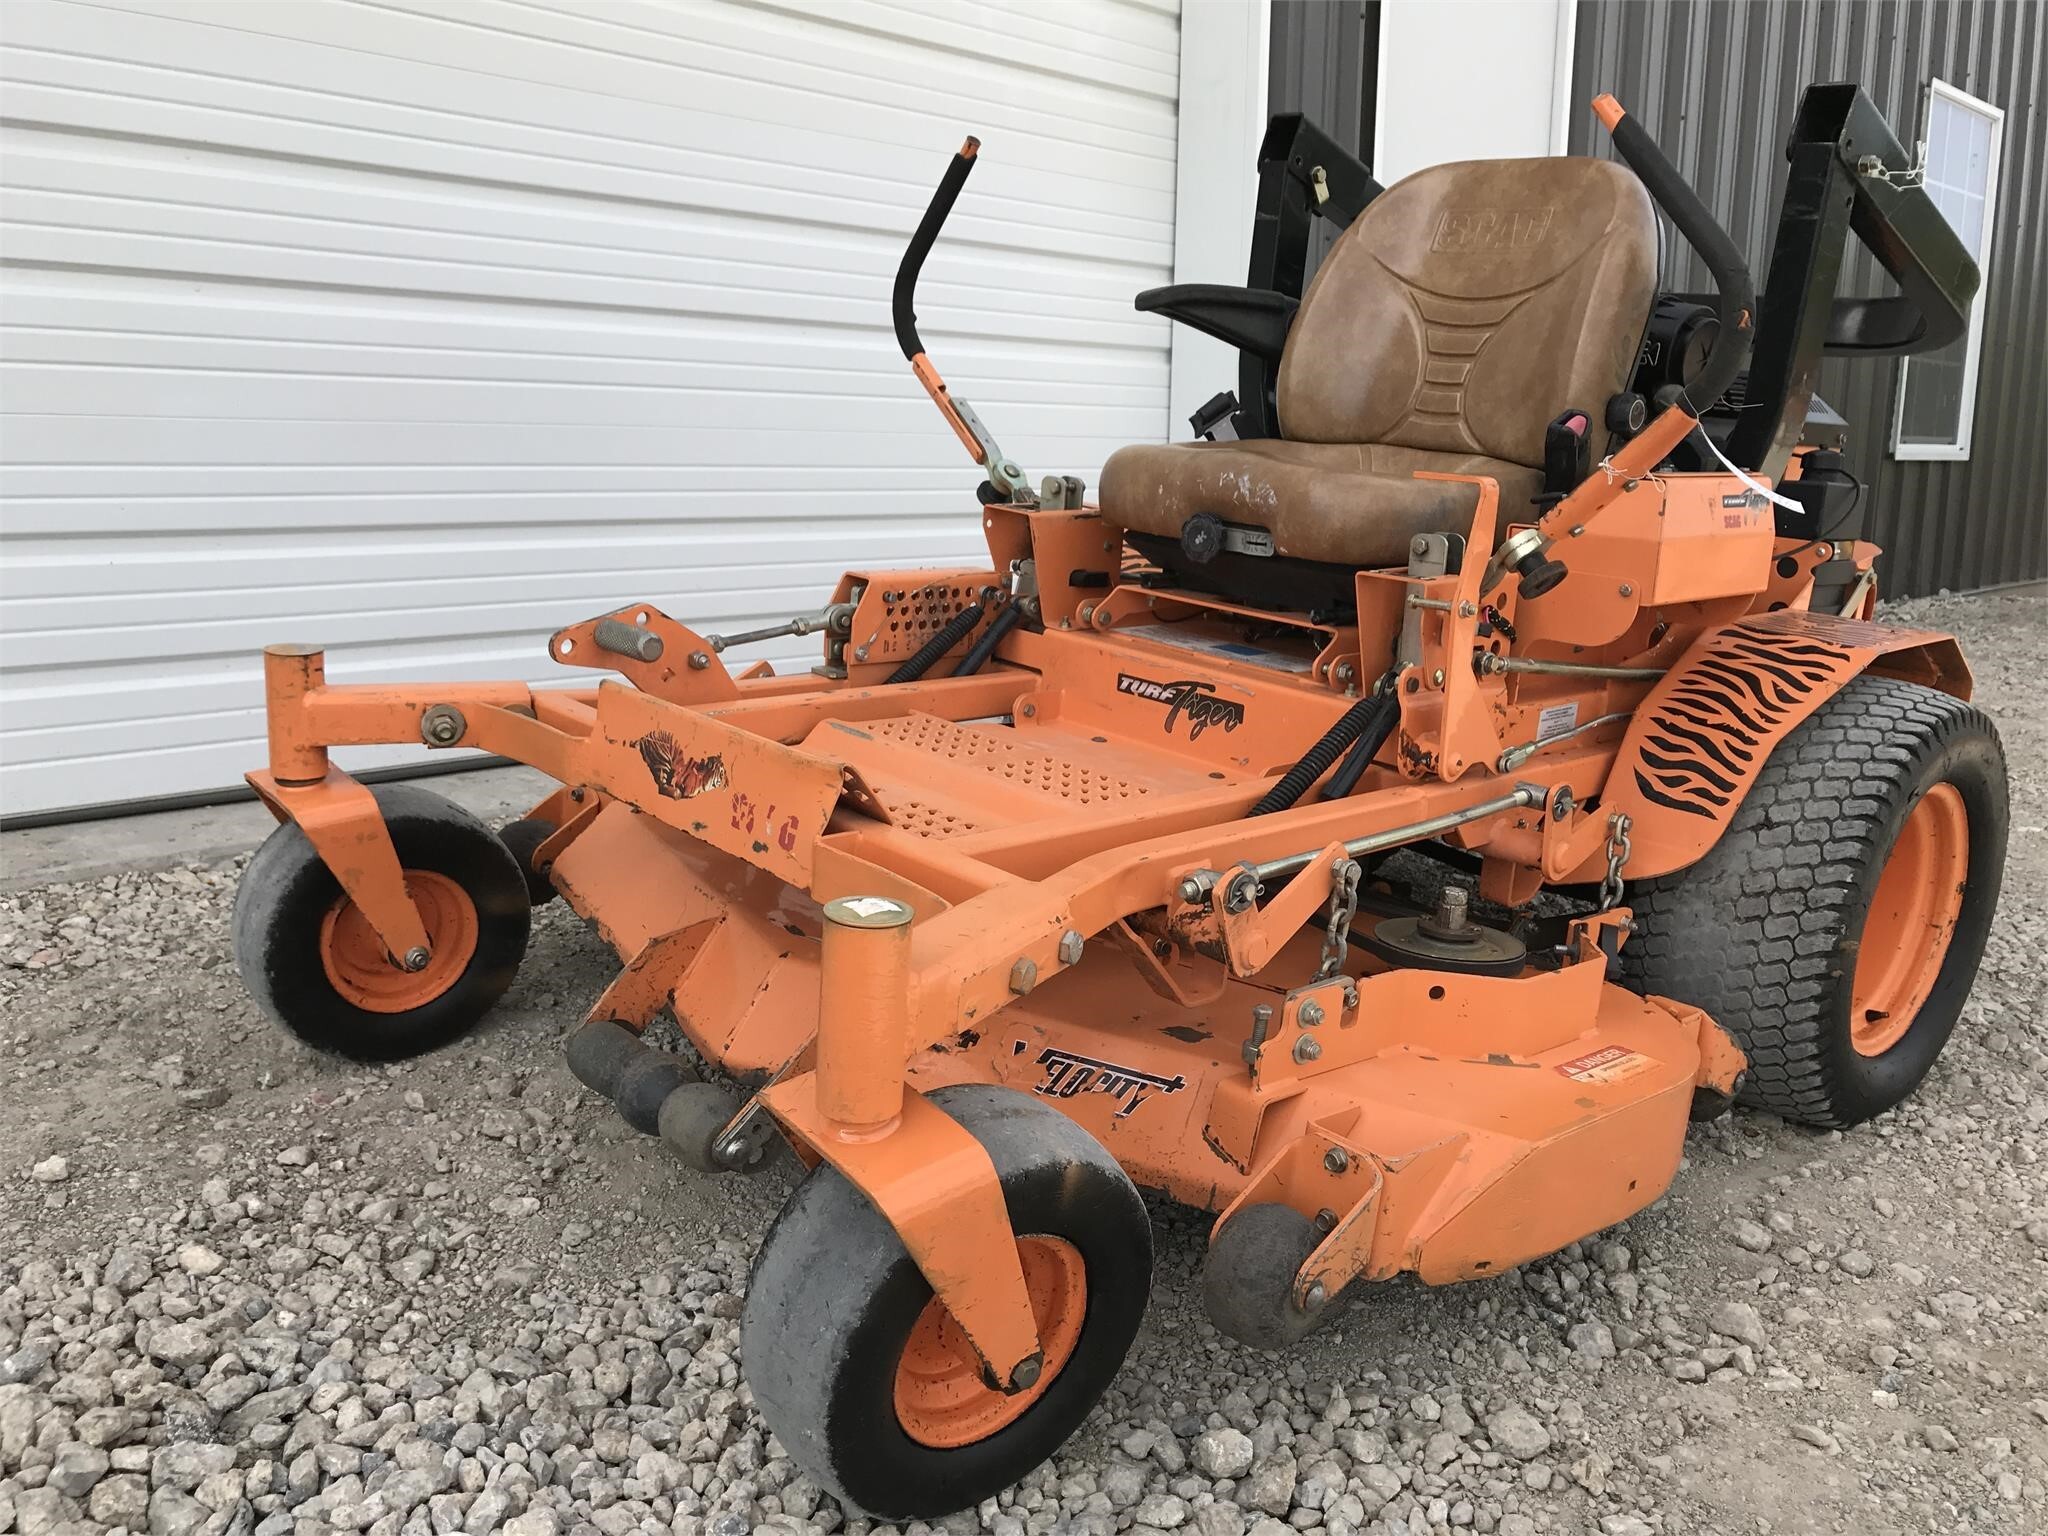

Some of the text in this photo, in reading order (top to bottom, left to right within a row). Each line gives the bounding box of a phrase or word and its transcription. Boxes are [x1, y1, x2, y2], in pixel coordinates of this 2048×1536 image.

[1119, 676, 1240, 741] TURF Tiger
[1577, 1048, 1626, 1069] DANGER
